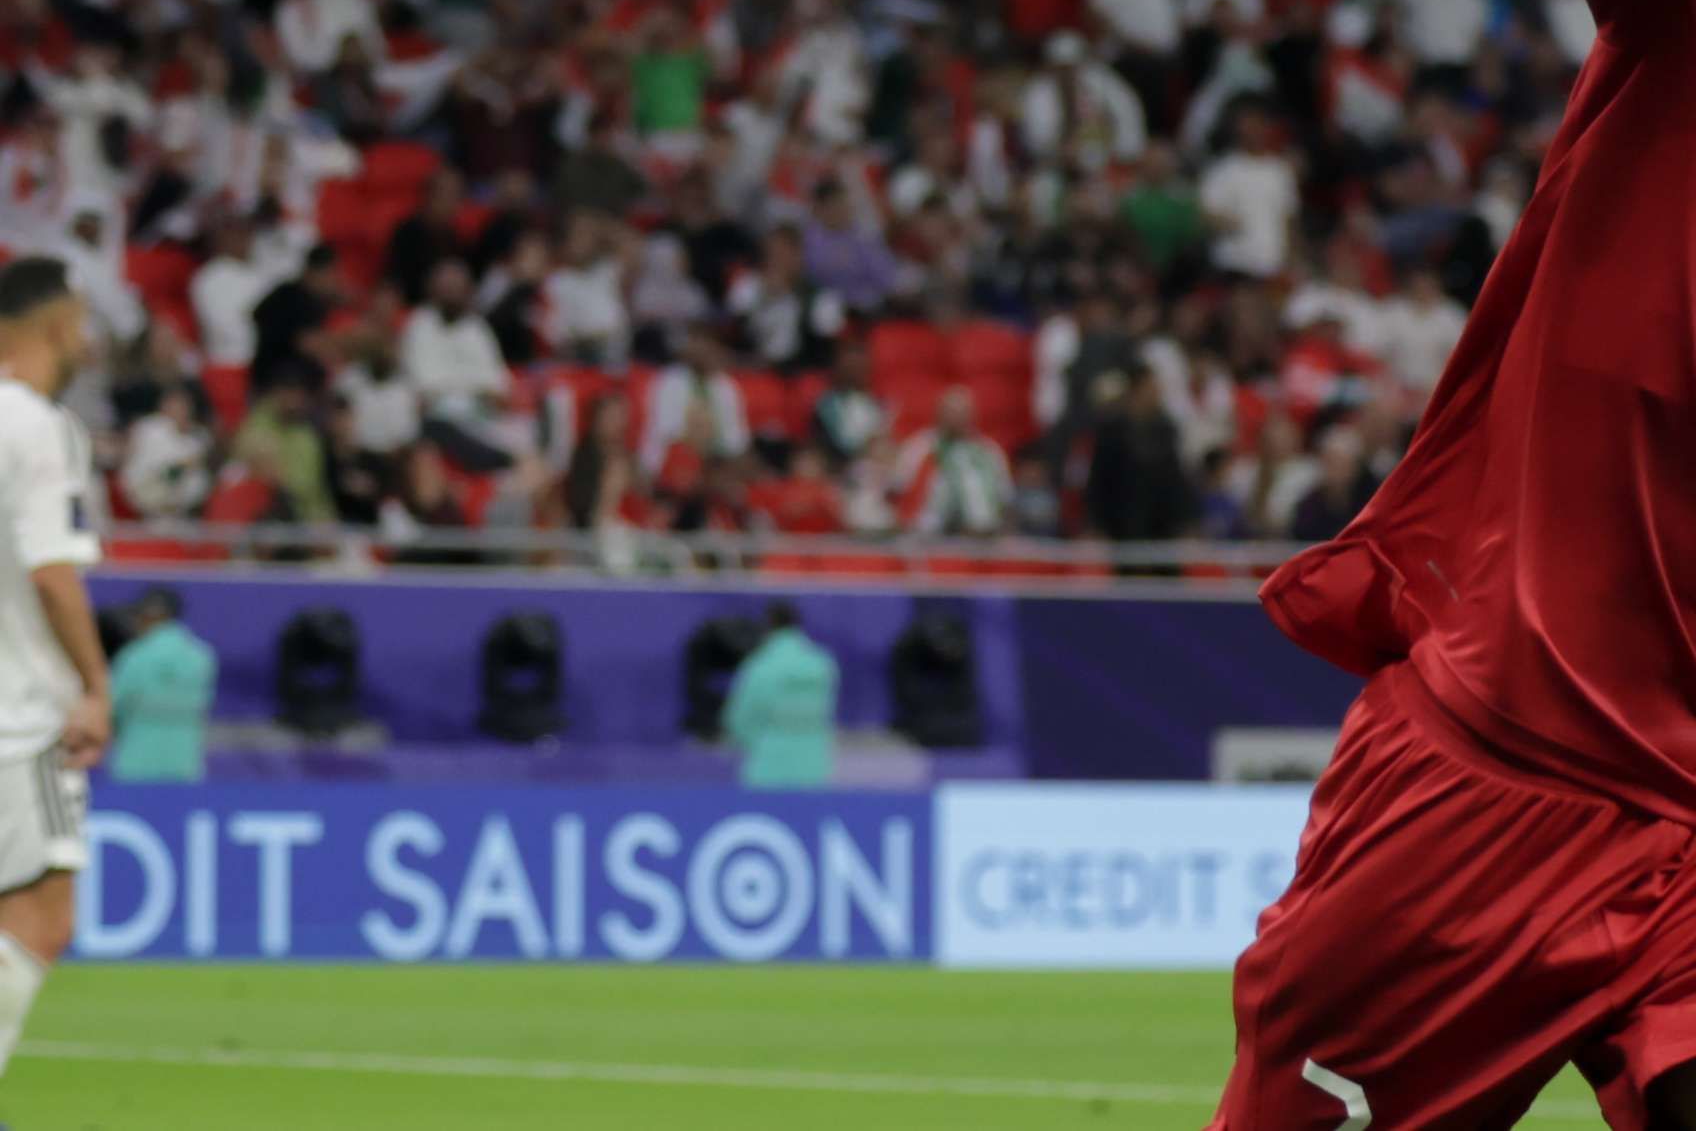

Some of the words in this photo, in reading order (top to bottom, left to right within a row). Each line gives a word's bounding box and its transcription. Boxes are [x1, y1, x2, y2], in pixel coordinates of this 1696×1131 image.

[74, 811, 323, 959] DIT
[361, 812, 914, 962] SAISON
[958, 846, 1223, 932] CREDIT
